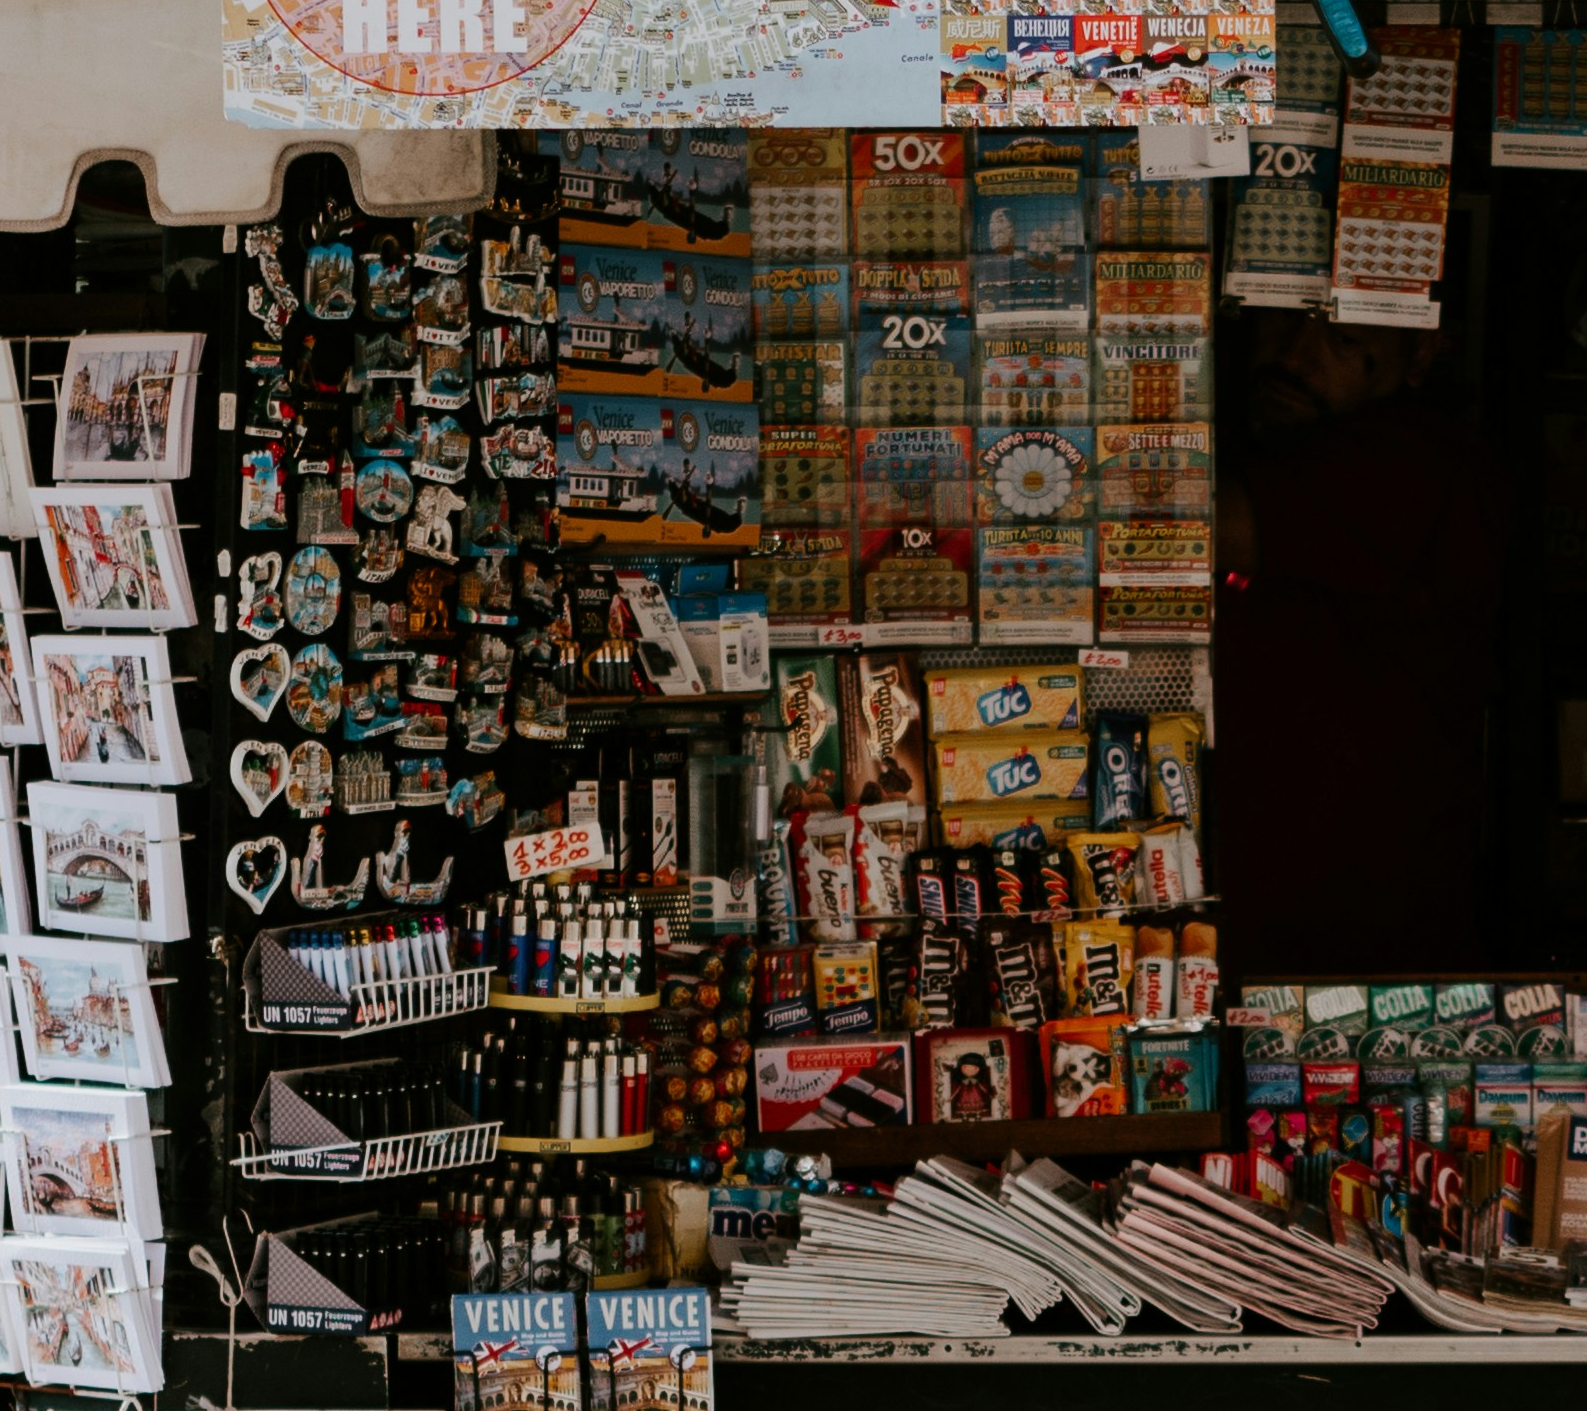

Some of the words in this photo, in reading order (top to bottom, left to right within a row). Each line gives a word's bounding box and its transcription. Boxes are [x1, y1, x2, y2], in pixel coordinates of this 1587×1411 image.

[946, 21, 1001, 40] 威尼斯
[1082, 17, 1138, 42] VENETIË
[1148, 18, 1206, 37] WENECJA
[1217, 17, 1271, 35] VENEZA
[689, 140, 740, 160] GONDOLA
[873, 135, 945, 171] 50X
[1255, 144, 1317, 178] 20X
[596, 257, 636, 281] Venice
[703, 266, 737, 288] Venice
[599, 282, 657, 299] VAPORETTO
[705, 290, 748, 308] GONDOLA
[882, 316, 947, 350] 20X
[593, 406, 634, 429] Venice
[705, 412, 744, 434] Venice
[596, 429, 653, 446] VAPORETTO
[877, 430, 951, 443] NUMERI
[1128, 433, 1159, 450] SETTE
[1171, 433, 1205, 451] MEZZO
[865, 443, 962, 458] FORTUNATI
[901, 528, 932, 549] 10X
[980, 684, 1030, 724] TUC
[989, 756, 1040, 794] TUC
[877, 855, 903, 916] bueno
[816, 867, 843, 930] bueno
[263, 1006, 280, 1023] UN
[283, 1007, 312, 1024] 1057
[763, 1003, 809, 1032] Tempo
[824, 1004, 870, 1034] Tempo
[1141, 1040, 1191, 1053] FORTNITE
[295, 1151, 323, 1168] 1057
[269, 1309, 287, 1326] UN
[291, 1309, 323, 1328] 1057
[465, 1297, 565, 1333] VENICE
[599, 1295, 700, 1330] VENICE
[325, 1321, 353, 1331] Lighters
